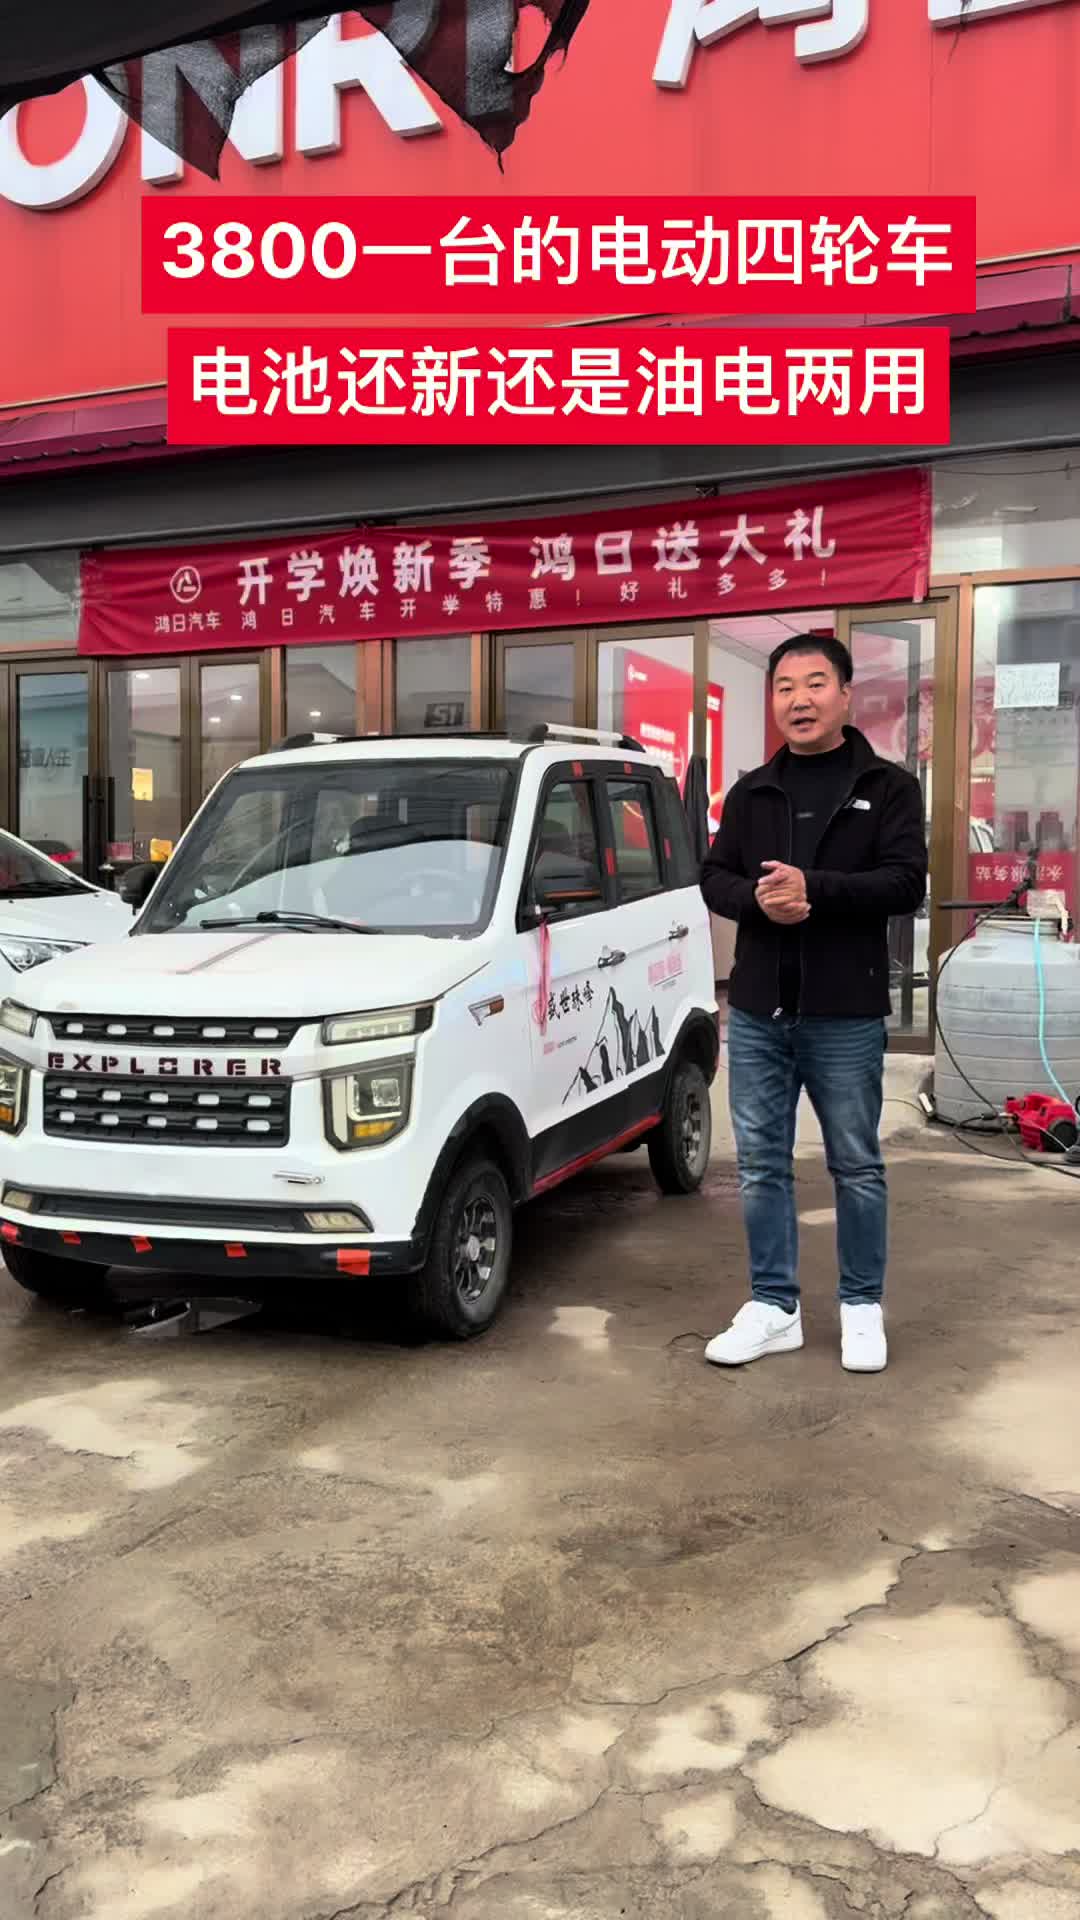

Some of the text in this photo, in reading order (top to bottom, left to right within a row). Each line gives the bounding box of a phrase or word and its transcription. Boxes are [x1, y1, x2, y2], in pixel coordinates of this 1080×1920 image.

[236, 505, 836, 606] 开学焕新季 鸿日送大礼
[154, 610, 222, 633] 鸿日汽车
[47, 1051, 283, 1076] EXPLORER
